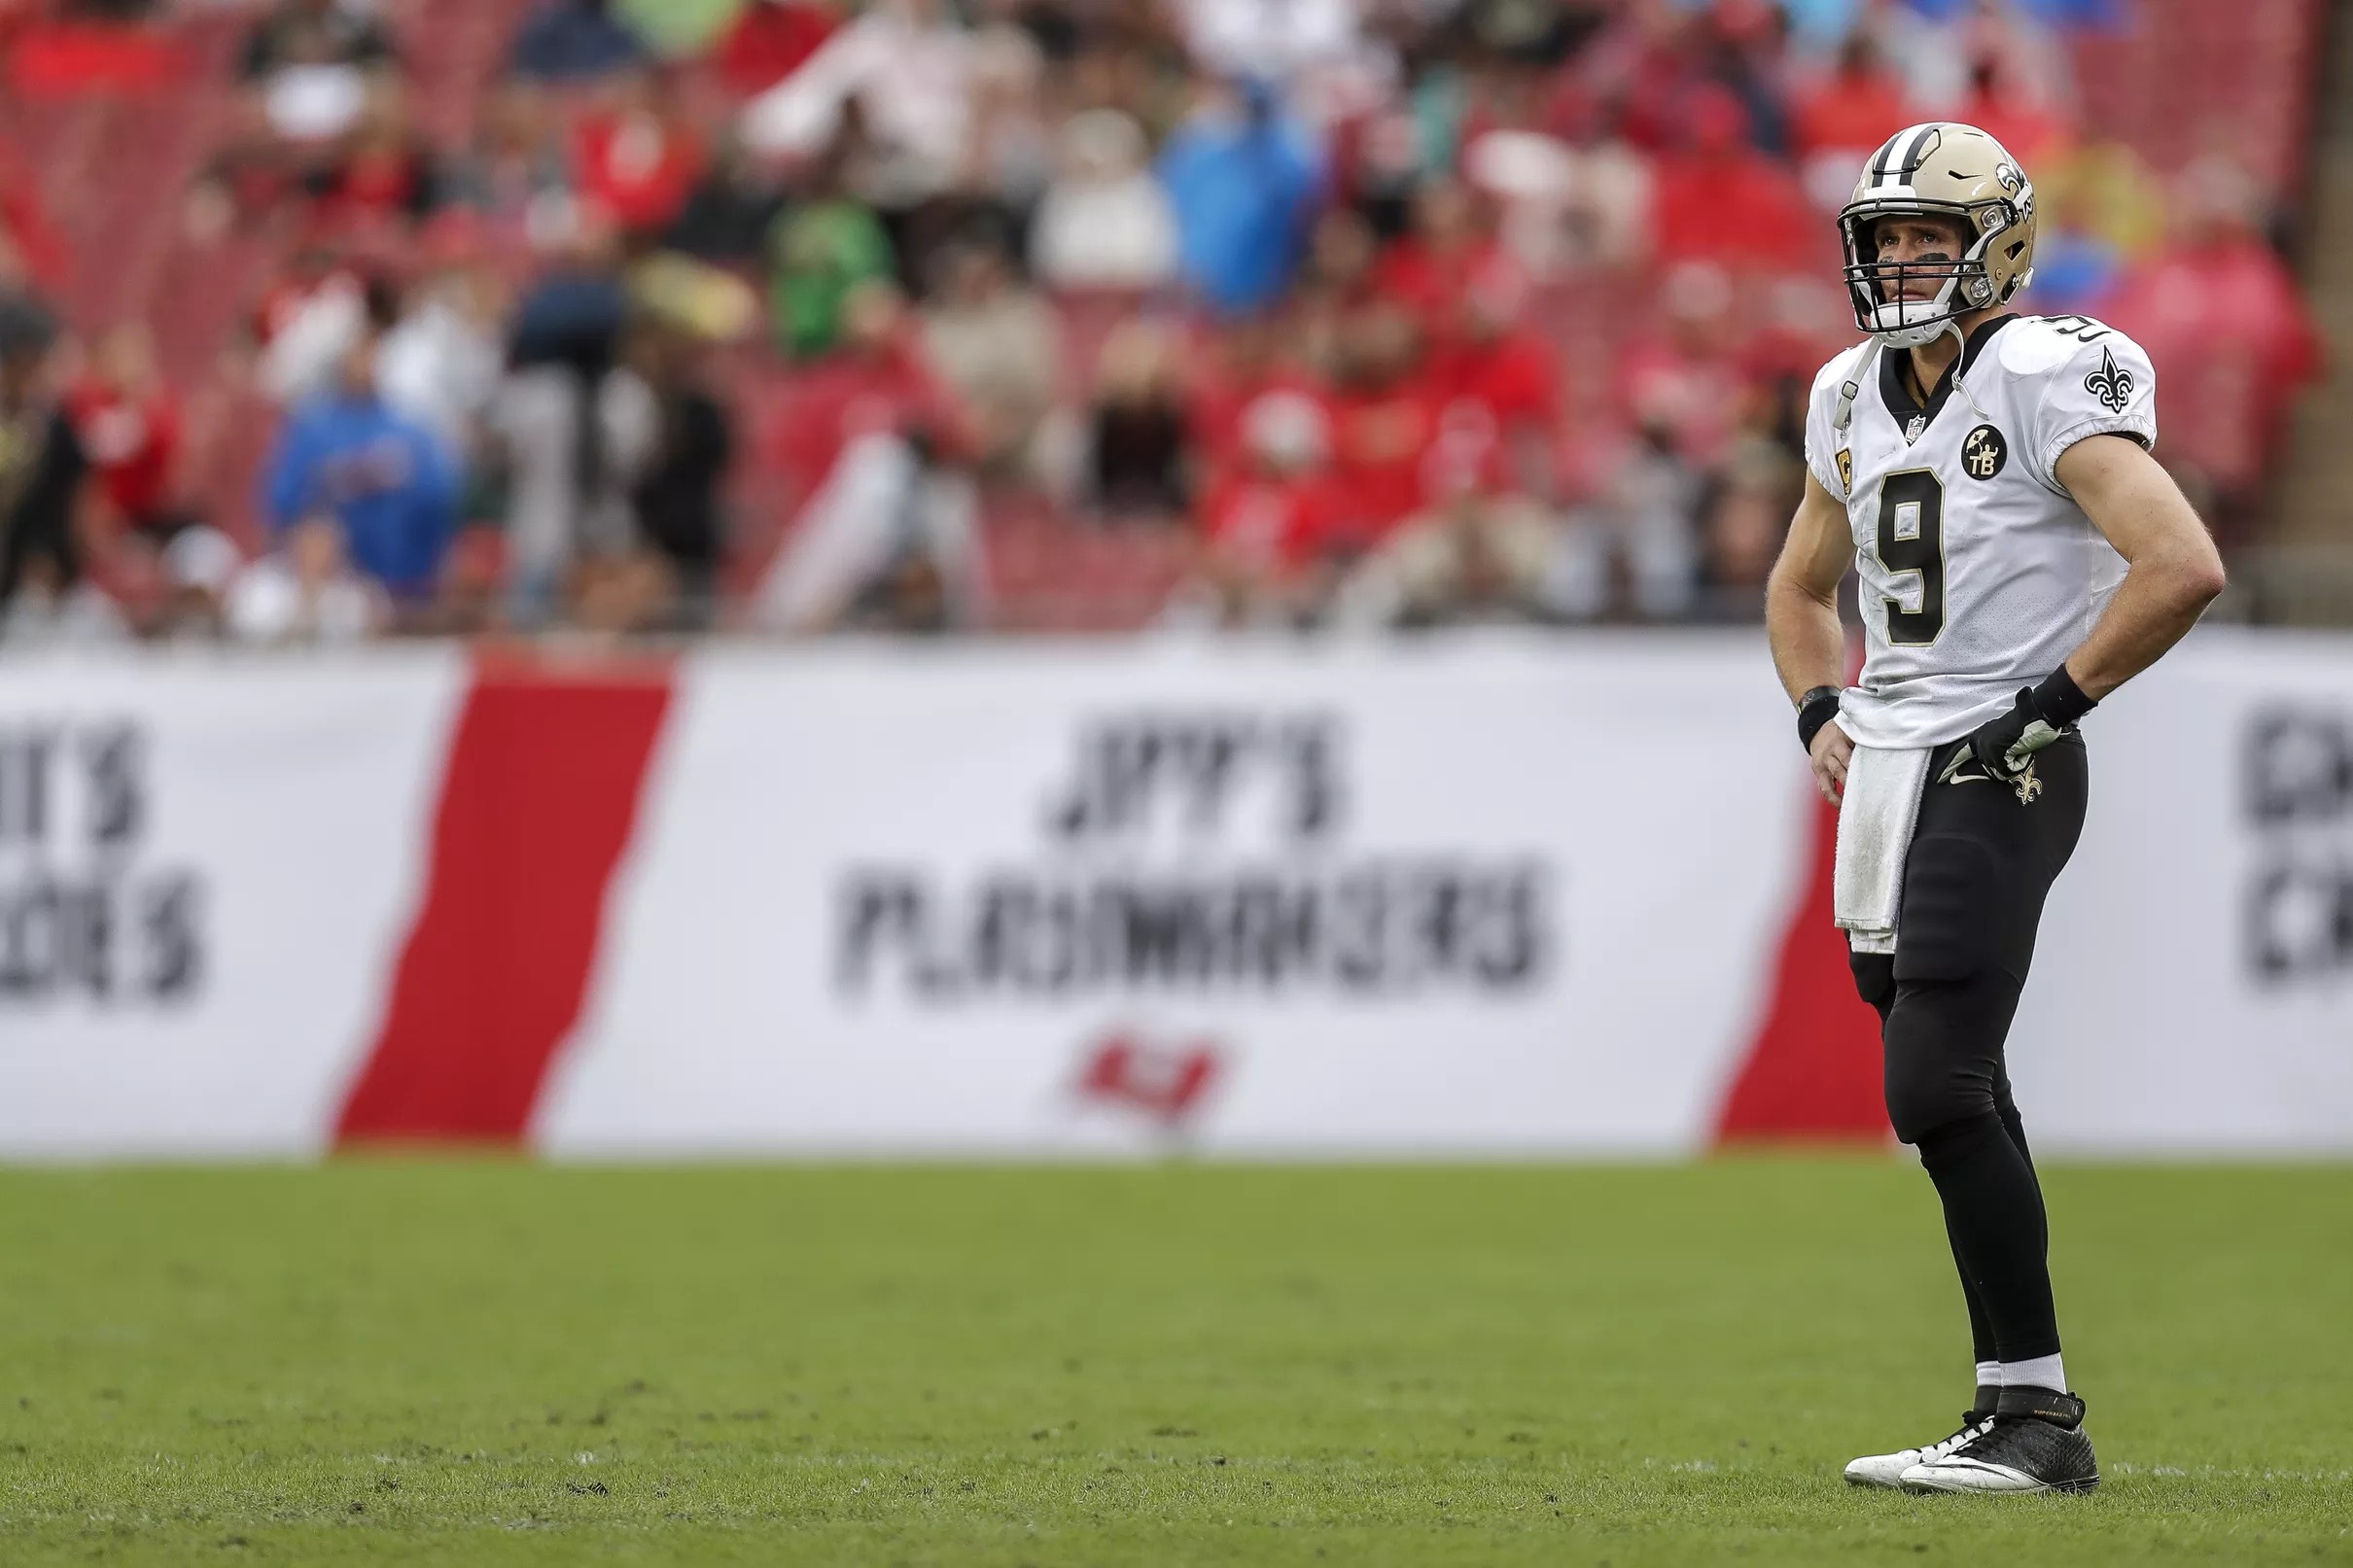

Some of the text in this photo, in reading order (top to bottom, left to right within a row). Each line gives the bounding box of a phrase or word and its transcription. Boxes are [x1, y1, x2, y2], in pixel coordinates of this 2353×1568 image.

[1969, 455, 1995, 475] TB
[1875, 468, 1947, 646] 9
[1045, 712, 1345, 841] JPP'S
[836, 860, 1548, 993] PLAYMAKERS
